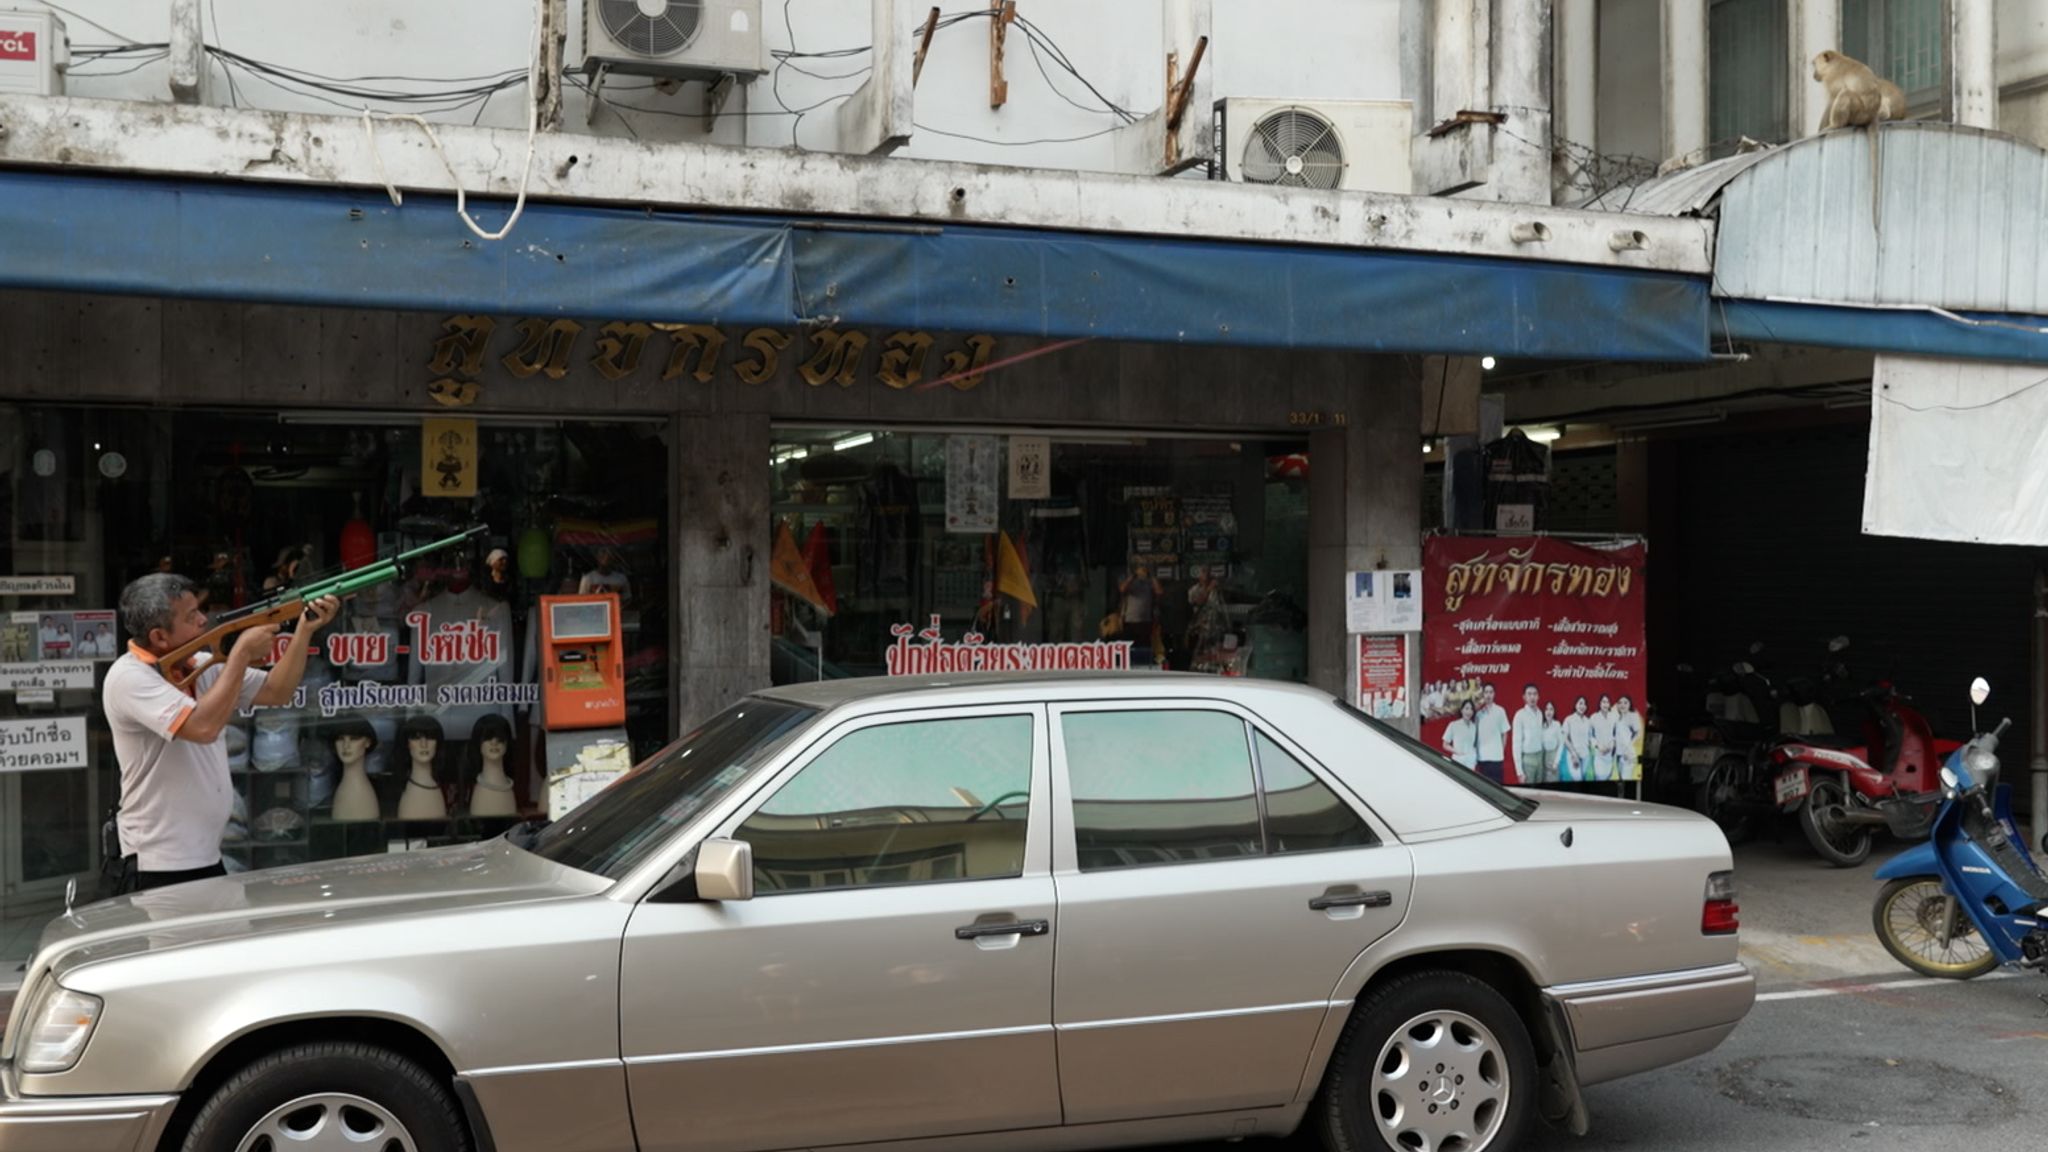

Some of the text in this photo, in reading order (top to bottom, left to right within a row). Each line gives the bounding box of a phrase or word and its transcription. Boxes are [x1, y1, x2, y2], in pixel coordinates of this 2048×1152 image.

[1444, 546, 1632, 611] สูทจักรทอง
[327, 632, 390, 665] ขาย
[407, 611, 501, 665] ให้เช่า
[886, 613, 1134, 676] ปักชื่อด้วยระบบคอมฯ
[437, 676, 540, 706] ราคาย่อมเย
